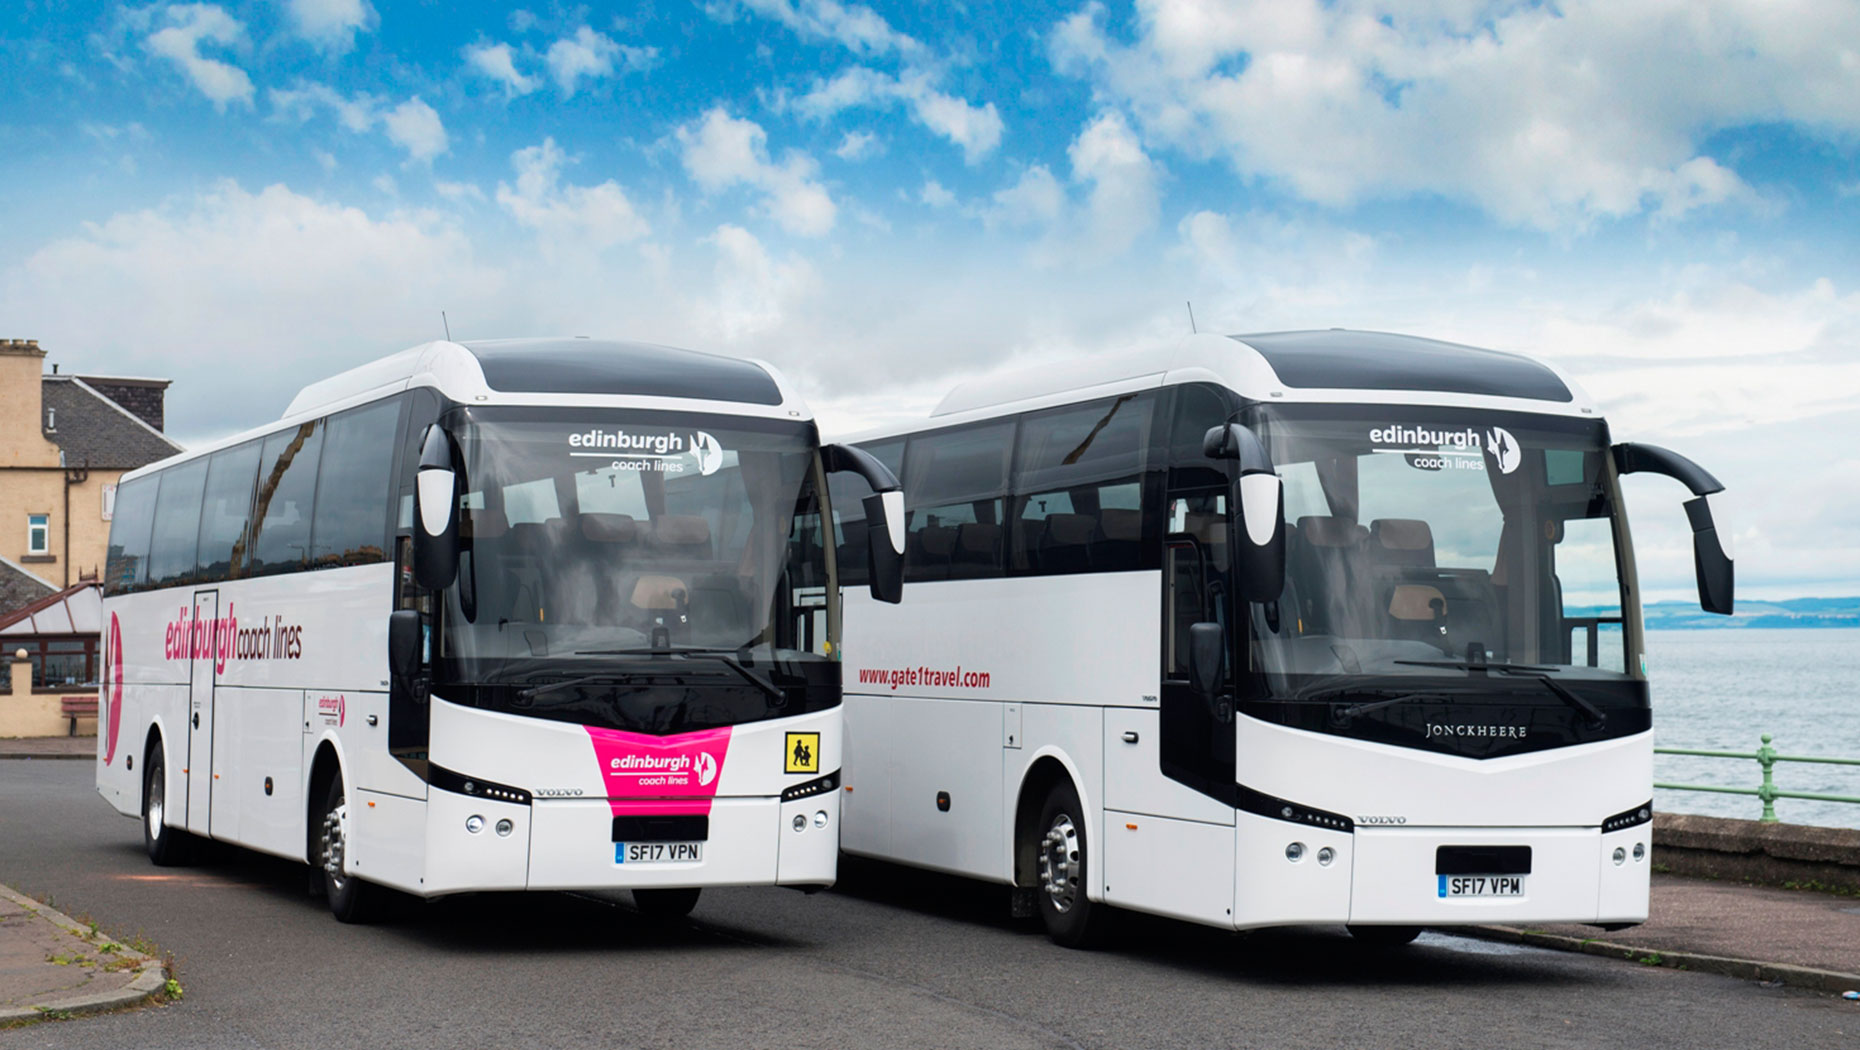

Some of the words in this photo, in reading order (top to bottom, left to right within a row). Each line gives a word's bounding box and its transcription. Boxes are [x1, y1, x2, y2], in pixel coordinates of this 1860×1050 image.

[568, 430, 683, 454] edinburgh
[1369, 425, 1480, 449] edinburgh
[611, 459, 651, 471] coach
[653, 460, 684, 473] lines
[1414, 457, 1452, 469] coach
[1455, 457, 1484, 471] lines
[165, 602, 238, 676] edinburgh
[237, 615, 271, 660] coach
[272, 614, 303, 660] lines
[858, 665, 991, 690] www.gate1travel.com
[1425, 723, 1527, 739] JONCKHEERE
[610, 754, 690, 772] edinburgh
[638, 776, 666, 786] coach
[667, 775, 689, 786] lines
[536, 788, 584, 797] VOLVO
[1356, 815, 1407, 825] VOLVO
[629, 845, 664, 861] SF17
[668, 844, 699, 860] VPN
[1451, 877, 1487, 895] SF17
[1490, 877, 1521, 895] VPM
